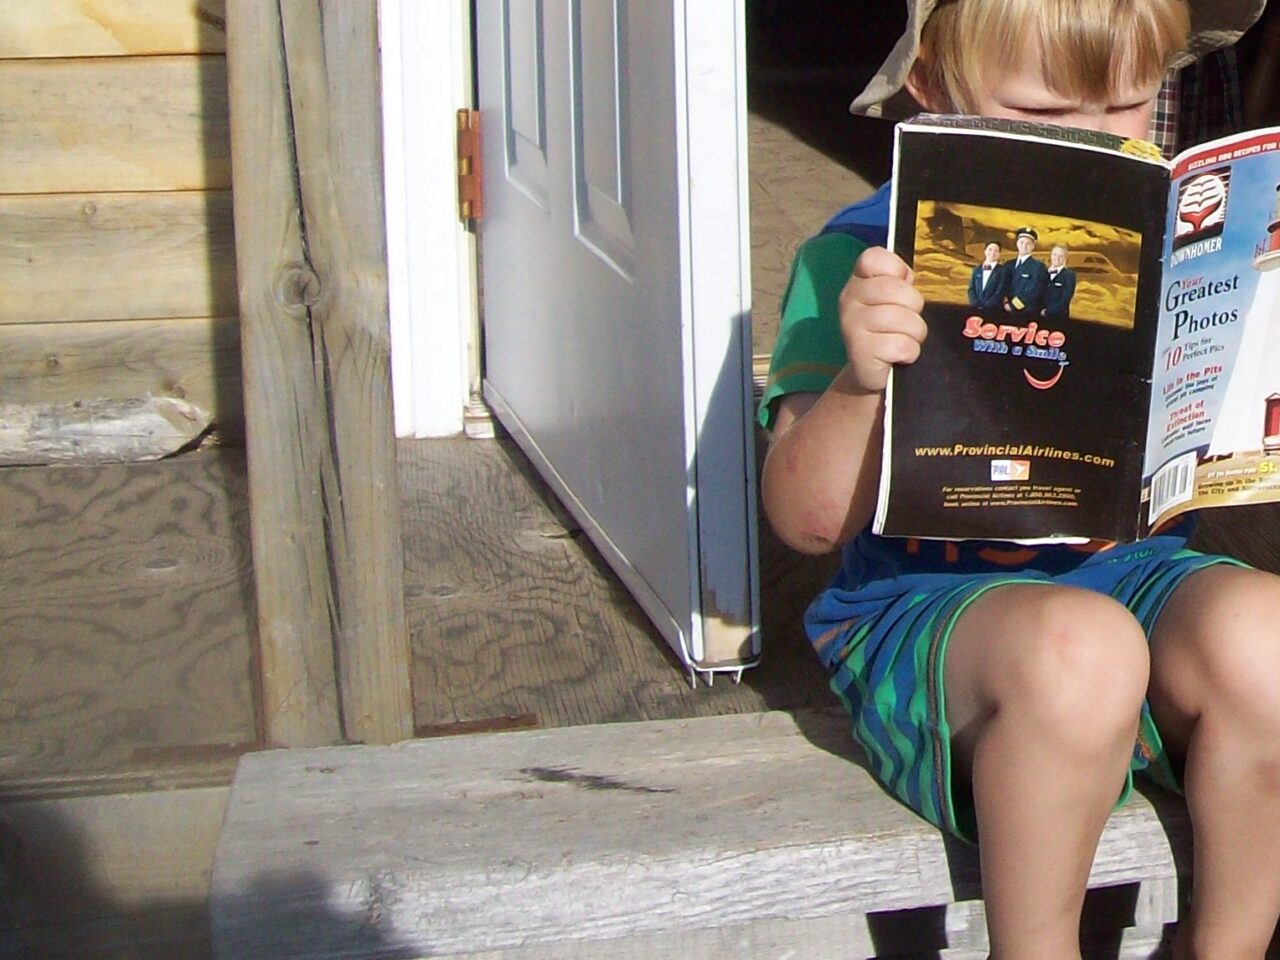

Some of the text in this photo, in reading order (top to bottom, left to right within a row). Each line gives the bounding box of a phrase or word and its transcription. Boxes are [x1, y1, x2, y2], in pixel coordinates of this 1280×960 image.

[1262, 143, 1277, 151] FOR
[1170, 238, 1222, 268] DOWNHOMER
[1166, 274, 1239, 312] Greatest
[1181, 277, 1204, 290] Your
[962, 316, 1066, 348] Service
[1172, 308, 1239, 341] Photos
[973, 339, 1067, 360] With a Smile
[1166, 346, 1182, 371] 10
[1187, 372, 1200, 381] the
[1204, 366, 1223, 376] Pits
[914, 444, 1115, 467] www.ProvincialAirlines.com
[1260, 461, 1279, 473] St.
